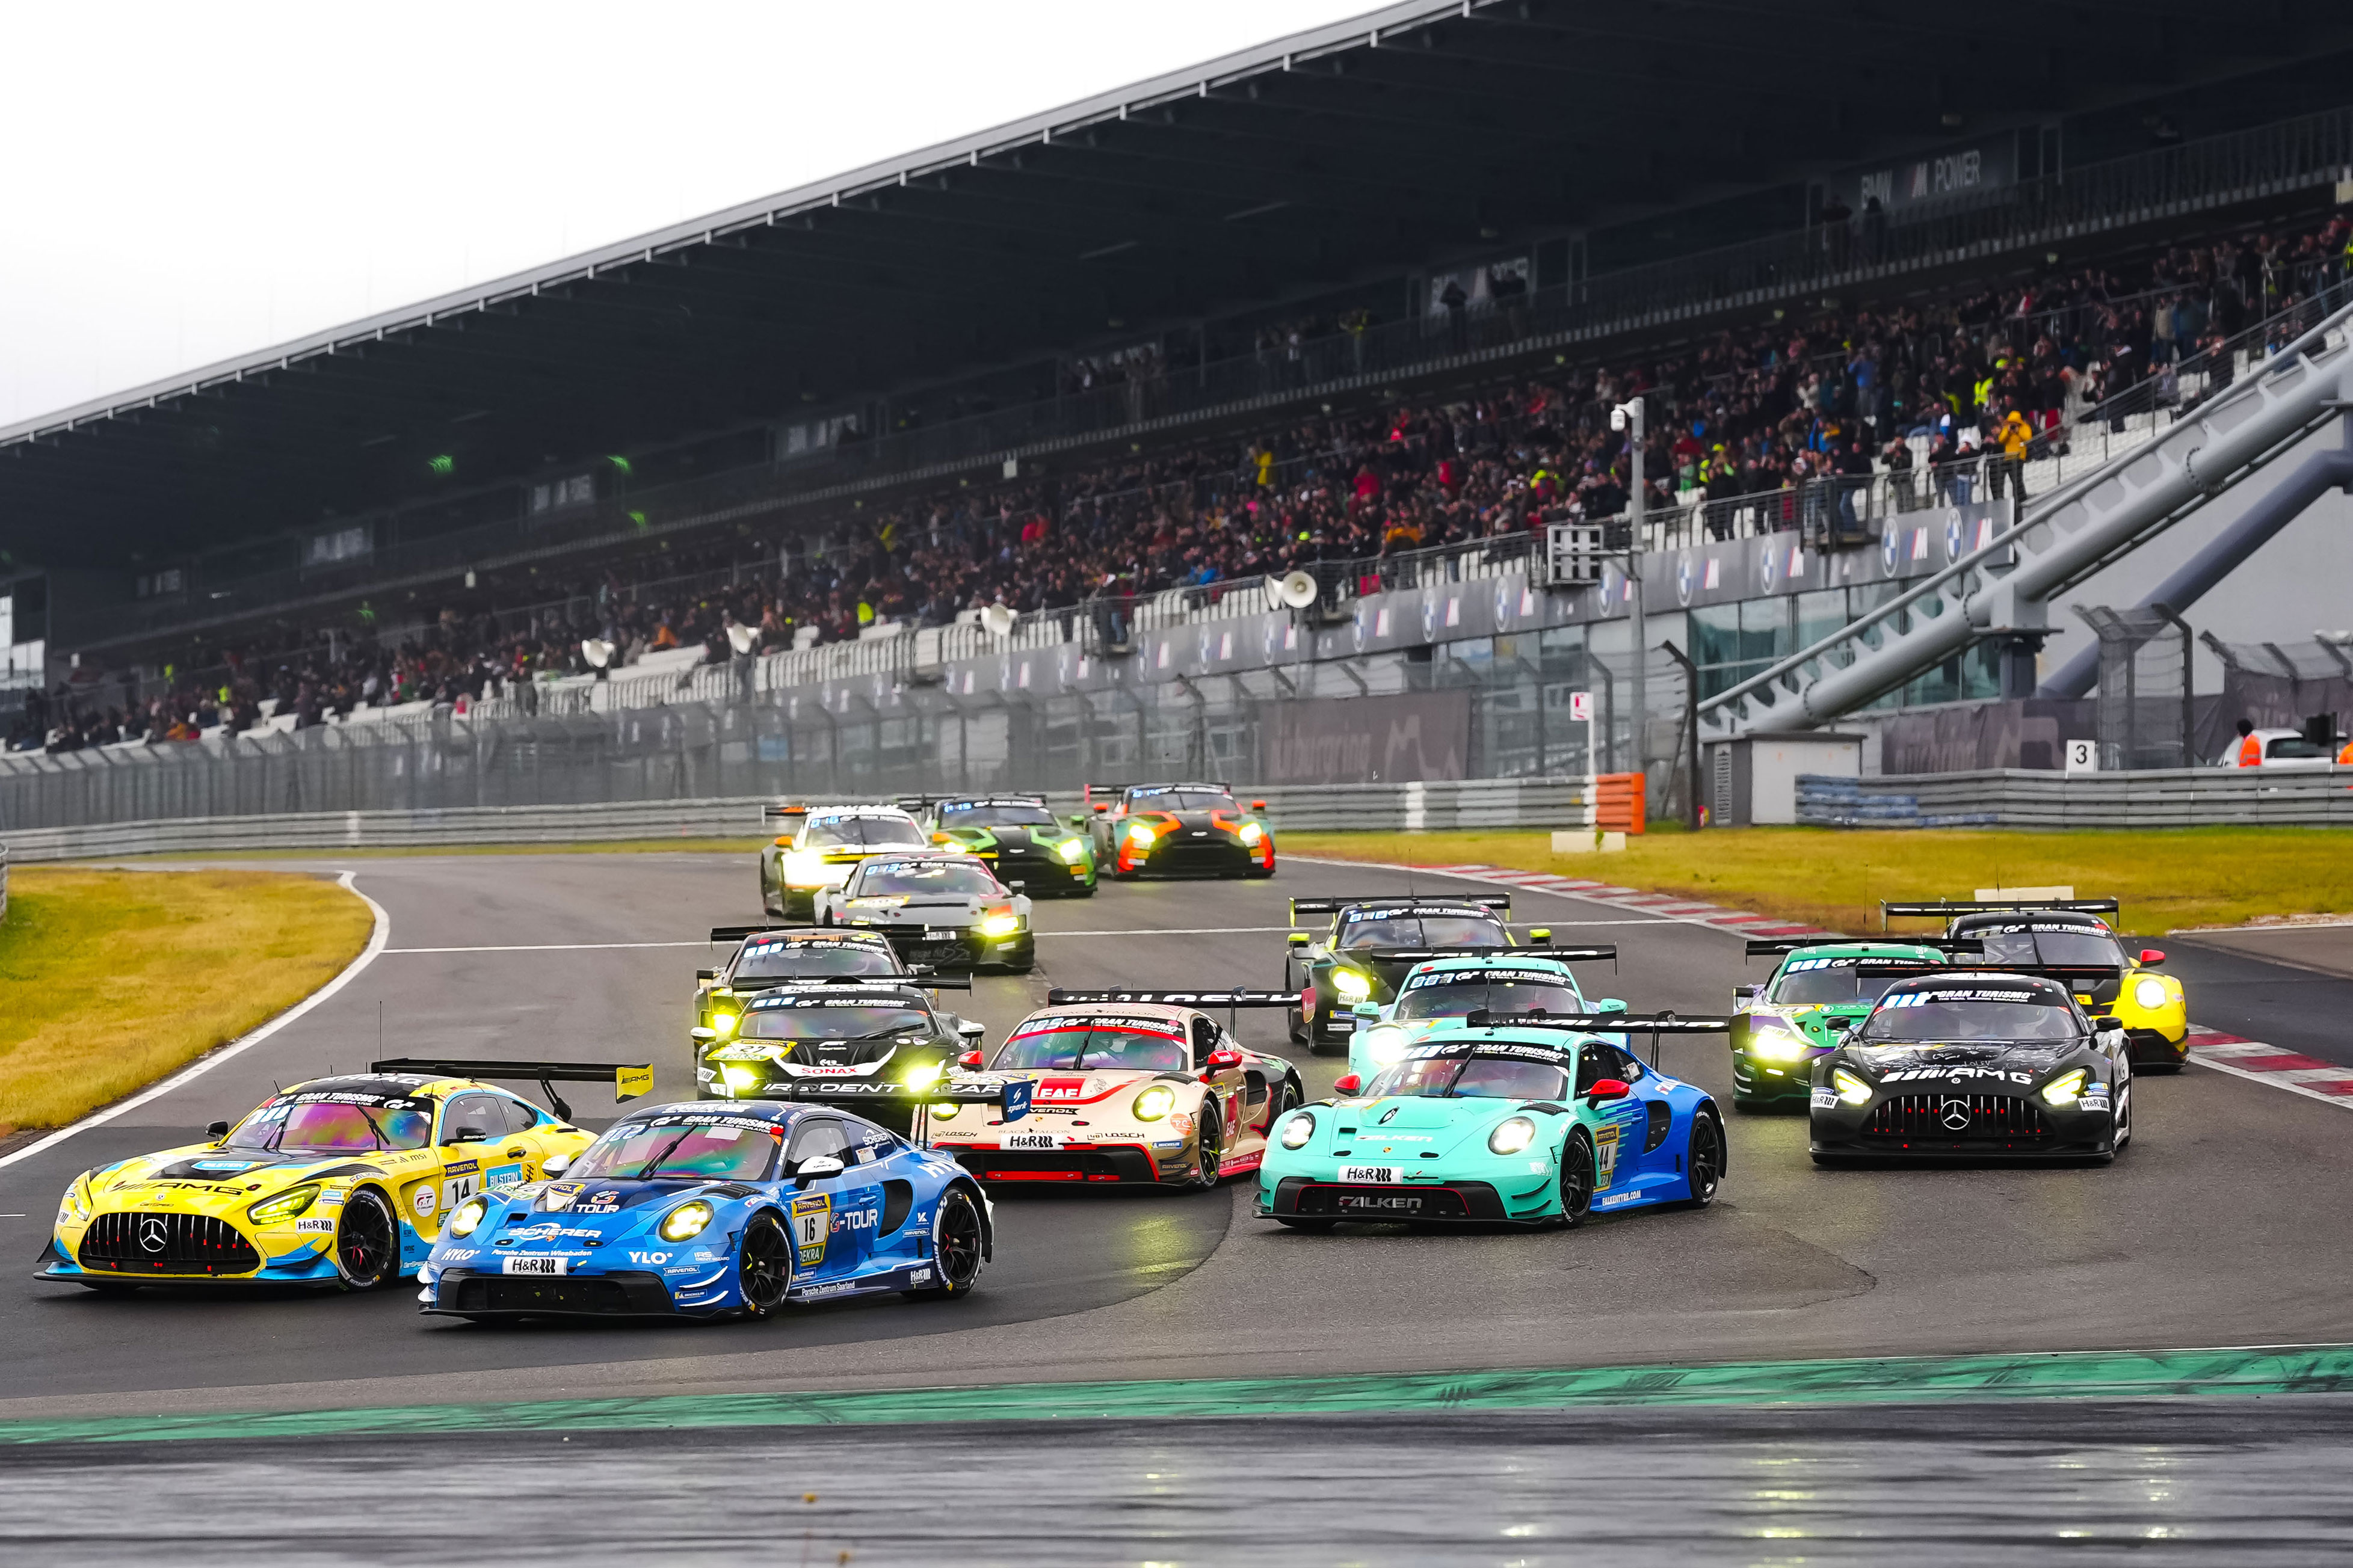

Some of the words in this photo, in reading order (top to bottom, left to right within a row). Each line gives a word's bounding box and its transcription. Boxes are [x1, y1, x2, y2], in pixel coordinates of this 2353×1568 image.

[1934, 149, 1981, 192] POWER
[2075, 745, 2088, 764] 3
[812, 940, 840, 948] GRAN
[1091, 1018, 1124, 1026] GRAN
[1474, 1044, 1506, 1053] GRAN
[630, 1074, 650, 1083] AMG
[1943, 1068, 2033, 1085] AMG
[820, 1083, 904, 1092] DENT
[1040, 1088, 1079, 1098] EAE
[295, 1092, 330, 1101] GRAN
[1007, 1101, 1028, 1114] spark
[2082, 1099, 2100, 1108] H&R
[682, 1115, 722, 1124] GRAN
[735, 1125, 771, 1134] SIMULATOR
[1010, 1136, 1037, 1148] H&R
[410, 1153, 427, 1161] msi
[1599, 1145, 1609, 1170] 44
[447, 1162, 477, 1174] RAVENOL
[1347, 1167, 1376, 1181] H&R
[350, 1173, 383, 1183] FALKEN
[490, 1171, 519, 1186] BILSTEIN
[150, 1182, 244, 1196] AMG
[452, 1178, 470, 1205] 14
[1339, 1196, 1422, 1208] FALKEN
[1602, 1190, 1641, 1207] FALKENTYRE.COM
[576, 1204, 620, 1213] TOUR
[798, 1199, 825, 1211] RAVENOL
[298, 1220, 319, 1229] H&R
[804, 1217, 815, 1242] 16
[508, 1227, 602, 1238] SCHERER
[799, 1247, 820, 1262] DEKRA
[512, 1259, 539, 1274] H&R
[801, 1286, 819, 1296] Porsche
[819, 1284, 837, 1294] Zentrum
[836, 1281, 856, 1291] Saarland
